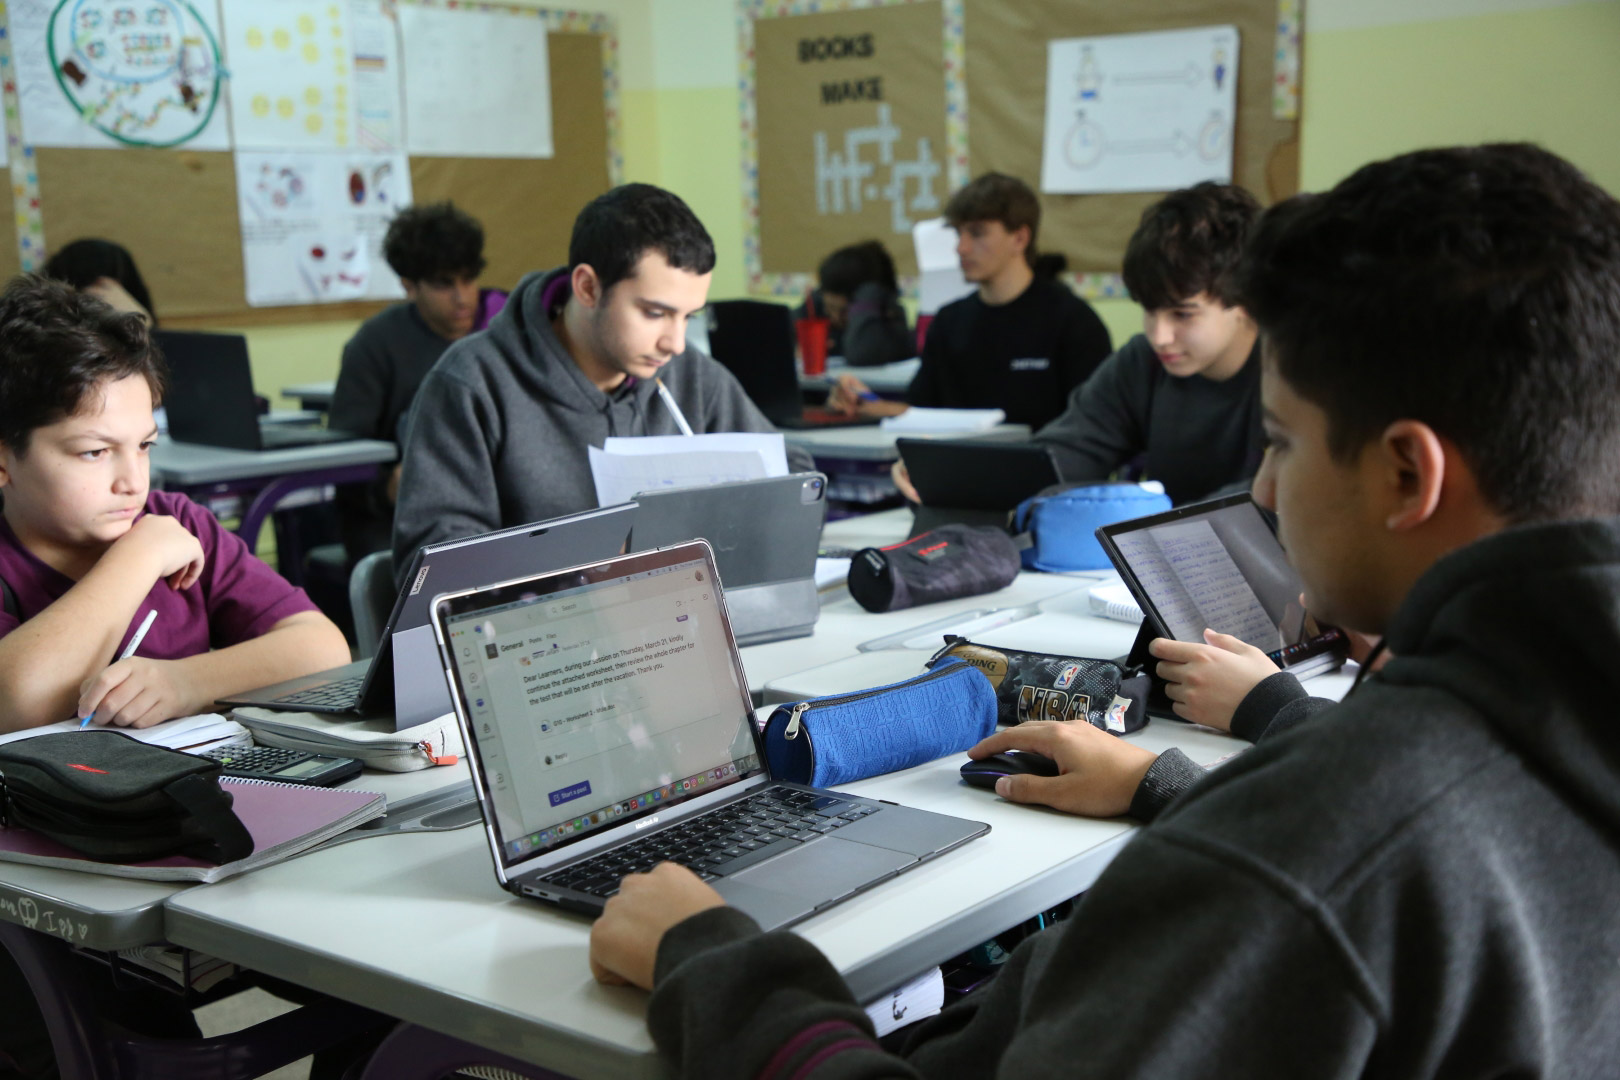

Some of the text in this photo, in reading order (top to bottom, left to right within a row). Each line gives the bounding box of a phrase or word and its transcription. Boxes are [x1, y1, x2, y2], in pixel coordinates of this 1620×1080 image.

[798, 33, 874, 62] BOOKS
[821, 77, 883, 104] MAKE
[412, 568, 426, 593] Lenovo
[501, 641, 524, 652] General
[523, 674, 537, 683] Dear
[538, 668, 564, 679] Learners,
[564, 663, 582, 672] during
[619, 646, 645, 656] Thursday,
[644, 640, 661, 650] March
[668, 634, 684, 643] kindly
[526, 683, 551, 694] continue
[561, 672, 586, 685] attached
[586, 665, 614, 678] worksheet,
[614, 661, 627, 669] then
[627, 657, 644, 666] review
[653, 649, 668, 658] whole
[668, 645, 687, 655] chapter
[966, 658, 997, 671] DING
[539, 694, 551, 702] test
[551, 691, 563, 699] that
[563, 687, 573, 696] will
[591, 679, 604, 688] after
[613, 670, 637, 682] vacation.
[636, 665, 653, 675] Thank
[653, 662, 665, 671] you.
[1017, 685, 1091, 723] NBA
[561, 790, 573, 799] Start
[577, 786, 588, 795] post
